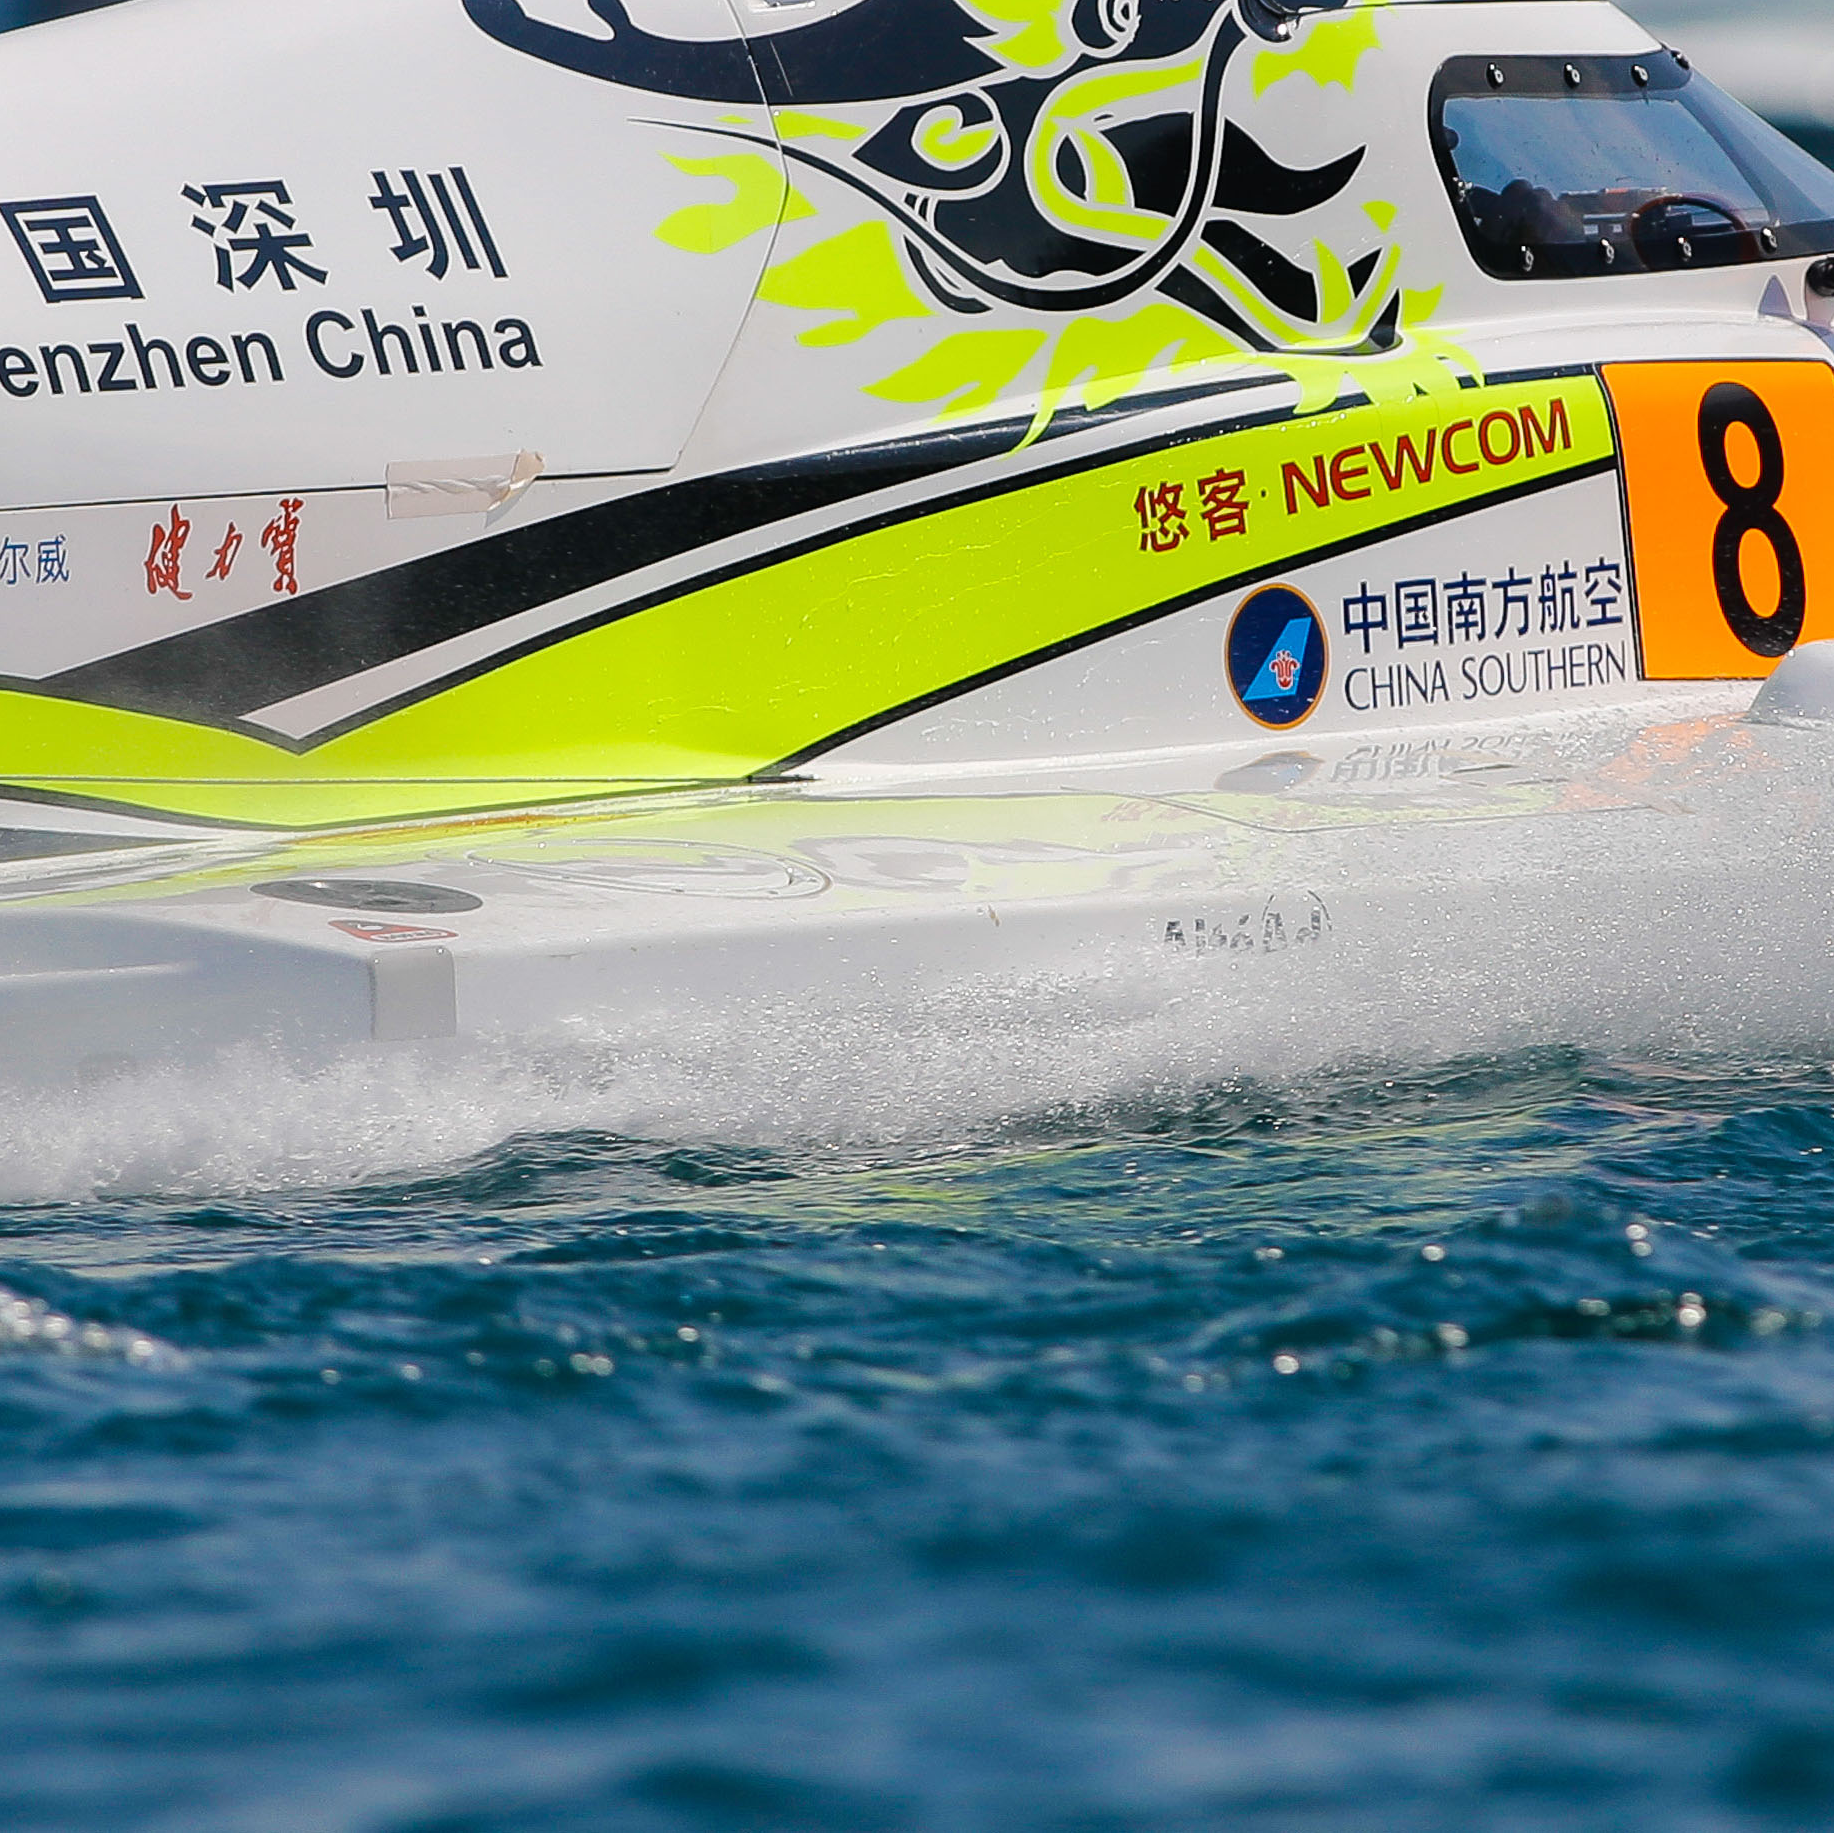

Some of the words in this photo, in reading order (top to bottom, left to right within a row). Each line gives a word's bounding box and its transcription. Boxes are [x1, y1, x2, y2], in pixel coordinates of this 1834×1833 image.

[305, 305, 543, 379] China
[1281, 398, 1572, 515] NEWCOM
[1697, 381, 1807, 658] 8
[1341, 557, 1624, 654] 中国南方航空
[1344, 660, 1450, 711] CHINA
[1461, 640, 1626, 700] SOUTHERN
